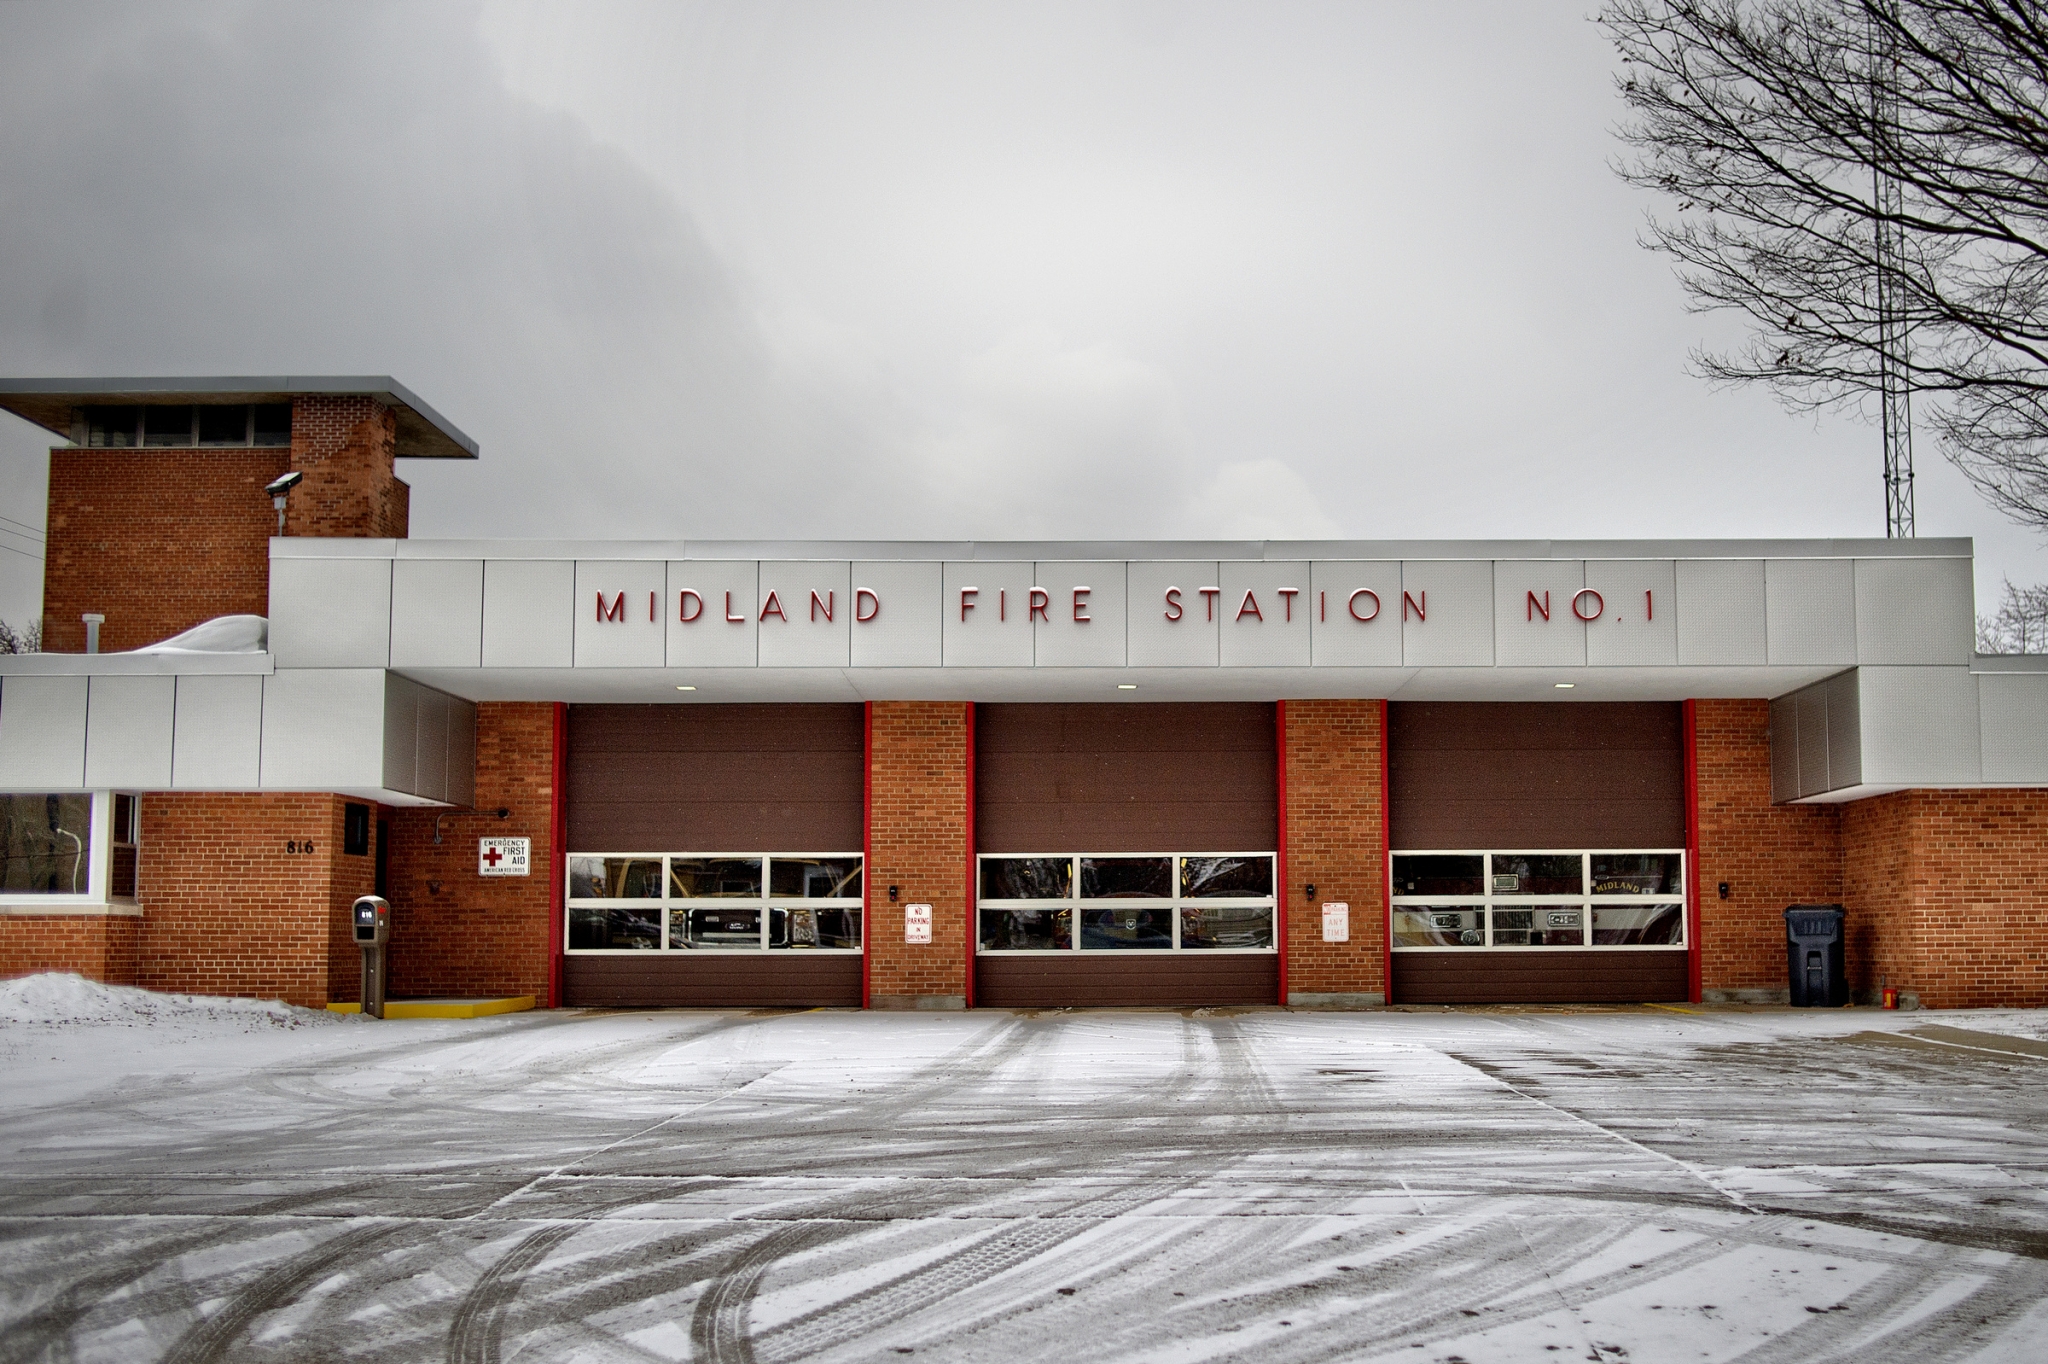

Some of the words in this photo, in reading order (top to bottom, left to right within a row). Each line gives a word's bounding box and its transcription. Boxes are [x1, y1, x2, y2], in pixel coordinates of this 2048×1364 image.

[596, 587, 880, 623] MIDLAND
[960, 586, 1092, 623] FIRE
[1163, 586, 1427, 623] STATION
[286, 840, 314, 854] 816
[503, 847, 525, 855] FIRST
[512, 856, 526, 865] AID
[1596, 881, 1640, 893] MIDLAND
[914, 907, 923, 916] NO
[907, 917, 930, 925] PARKING
[1328, 918, 1344, 926] ANY
[1326, 929, 1346, 937] TIME
